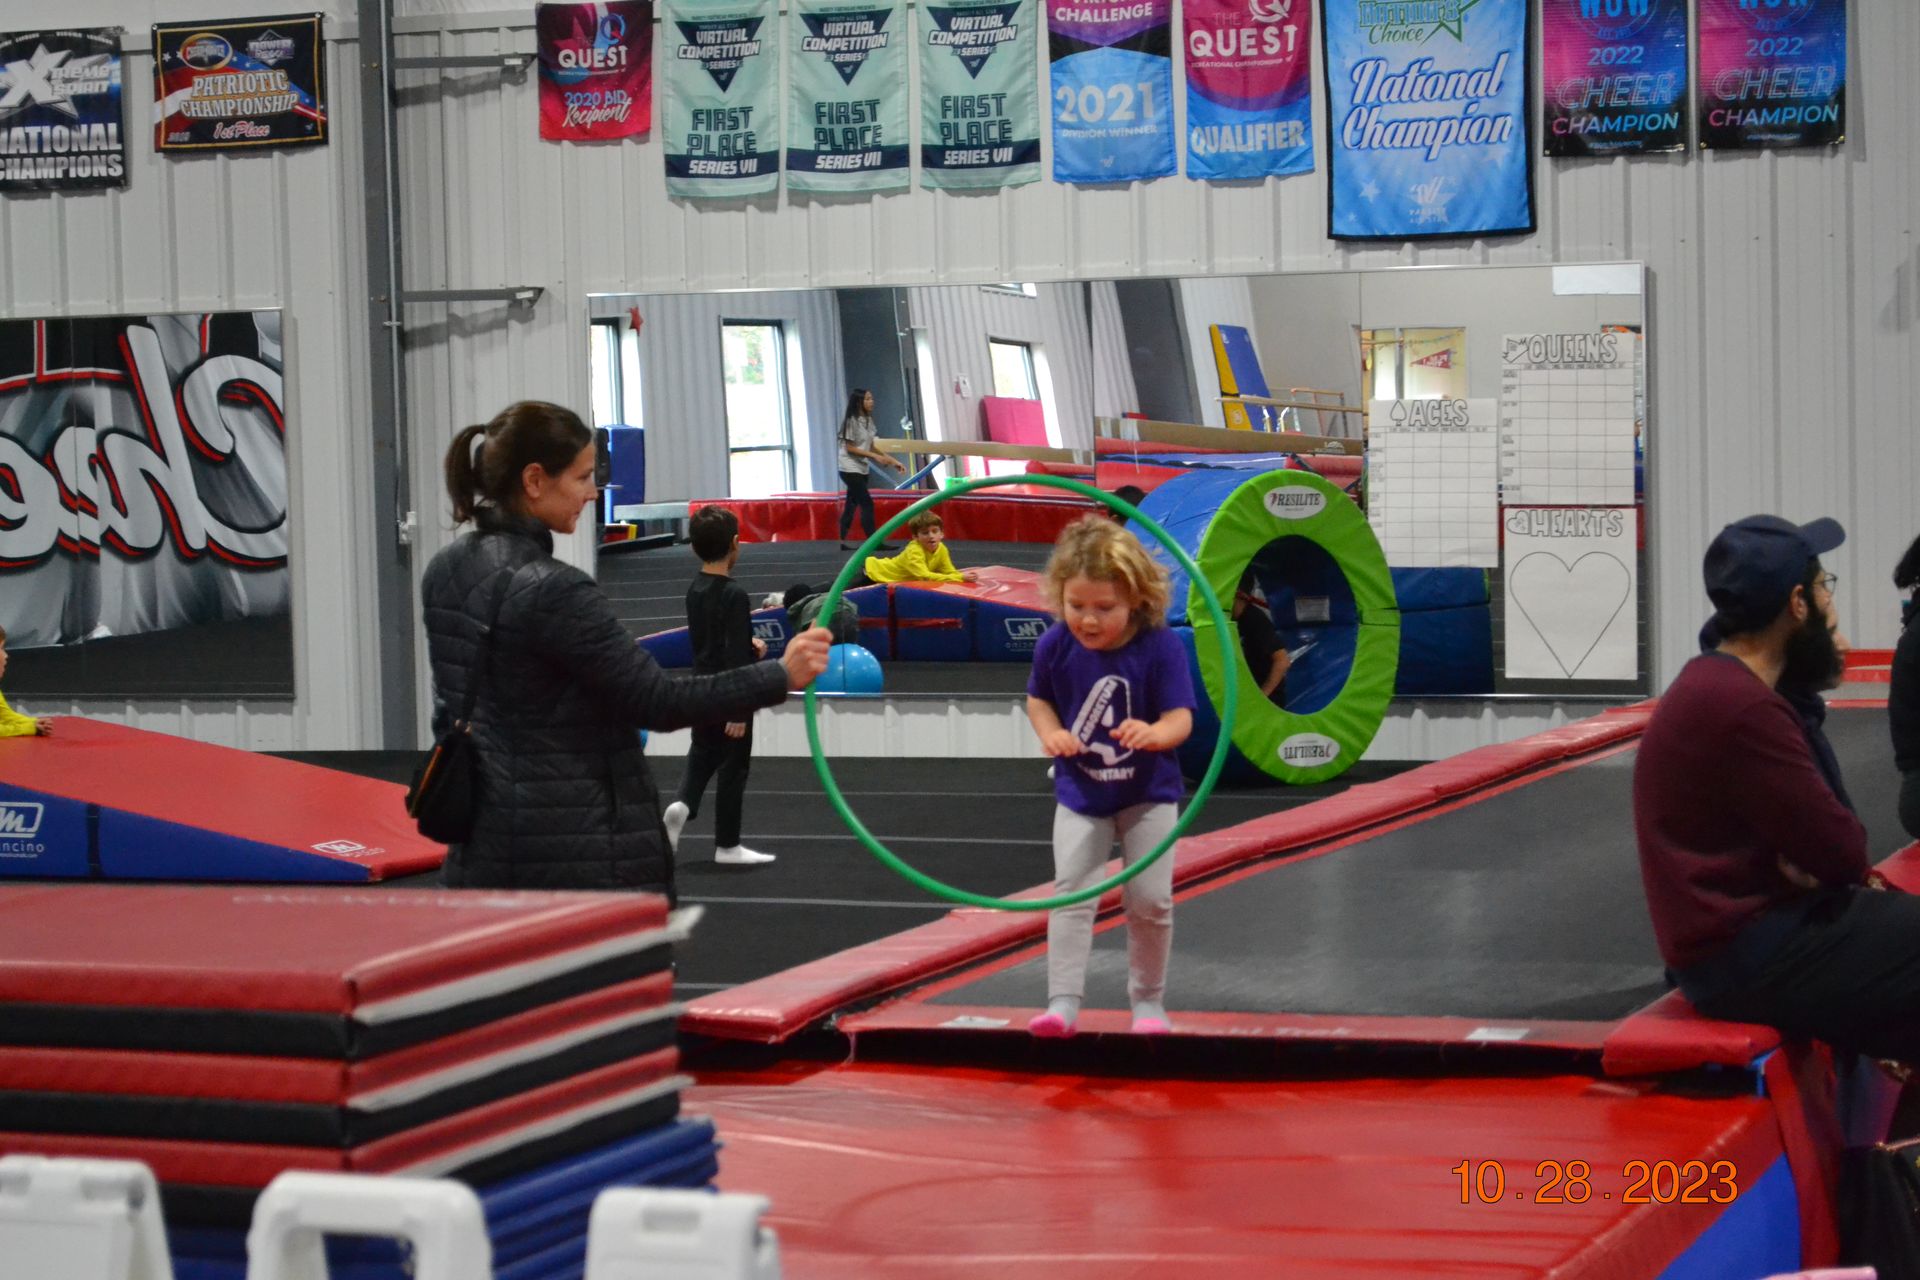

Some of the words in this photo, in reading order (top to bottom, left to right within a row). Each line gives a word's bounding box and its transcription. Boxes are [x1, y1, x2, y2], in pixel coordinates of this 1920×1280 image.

[950, 14, 1004, 31] VIRTUAL
[1055, 2, 1153, 23] CHALLENGE
[1214, 12, 1241, 25] THE
[696, 28, 748, 44] VIRTUAL
[823, 21, 876, 36] VIRTUAL
[928, 26, 1017, 46] COMPETITION
[1369, 21, 1424, 45] Choice
[679, 41, 760, 59] COMPETITION
[802, 33, 888, 51] COMPETITION
[961, 46, 989, 56] SERIES
[1189, 24, 1298, 57] QUEST
[1746, 37, 1804, 57] 2022
[558, 45, 628, 68] QUEST
[709, 60, 737, 70] SERIES
[834, 53, 861, 62] SERIES
[1587, 46, 1645, 66] 2022
[191, 69, 288, 97] PATRIOTIC
[1351, 50, 1510, 105] National
[1713, 64, 1837, 101] CHEER
[564, 92, 601, 107] 2020
[605, 89, 627, 106] BID
[1556, 71, 1677, 109] CHEER
[180, 92, 299, 118] CHAMPIONSHIP
[562, 97, 632, 129] Recipient
[814, 99, 880, 125] FIRST
[940, 92, 1007, 119] FIRST
[1056, 81, 1154, 123] 2021
[692, 106, 753, 131] FIRST
[1552, 112, 1679, 135] CHAMPION
[1709, 104, 1840, 127] CHAMPION
[234, 121, 270, 138] Place
[813, 125, 882, 151] PLACE
[939, 119, 1013, 146] PLACE
[1062, 128, 1107, 138] DIVISION
[1109, 125, 1157, 137] WINNER
[1191, 120, 1305, 155] QUALIFIER
[1342, 102, 1513, 162] Champion
[686, 131, 757, 157] PLACE
[688, 159, 737, 175] SERIES
[740, 158, 758, 173] VII
[815, 153, 862, 169] SERIES
[863, 151, 882, 167] VII
[944, 149, 989, 165] SERIES
[992, 147, 1013, 162] VII
[1527, 334, 1618, 364] QUEENS
[1408, 399, 1470, 427] ACES
[1277, 493, 1321, 506] RESILITE
[1530, 510, 1624, 538] HEARTS
